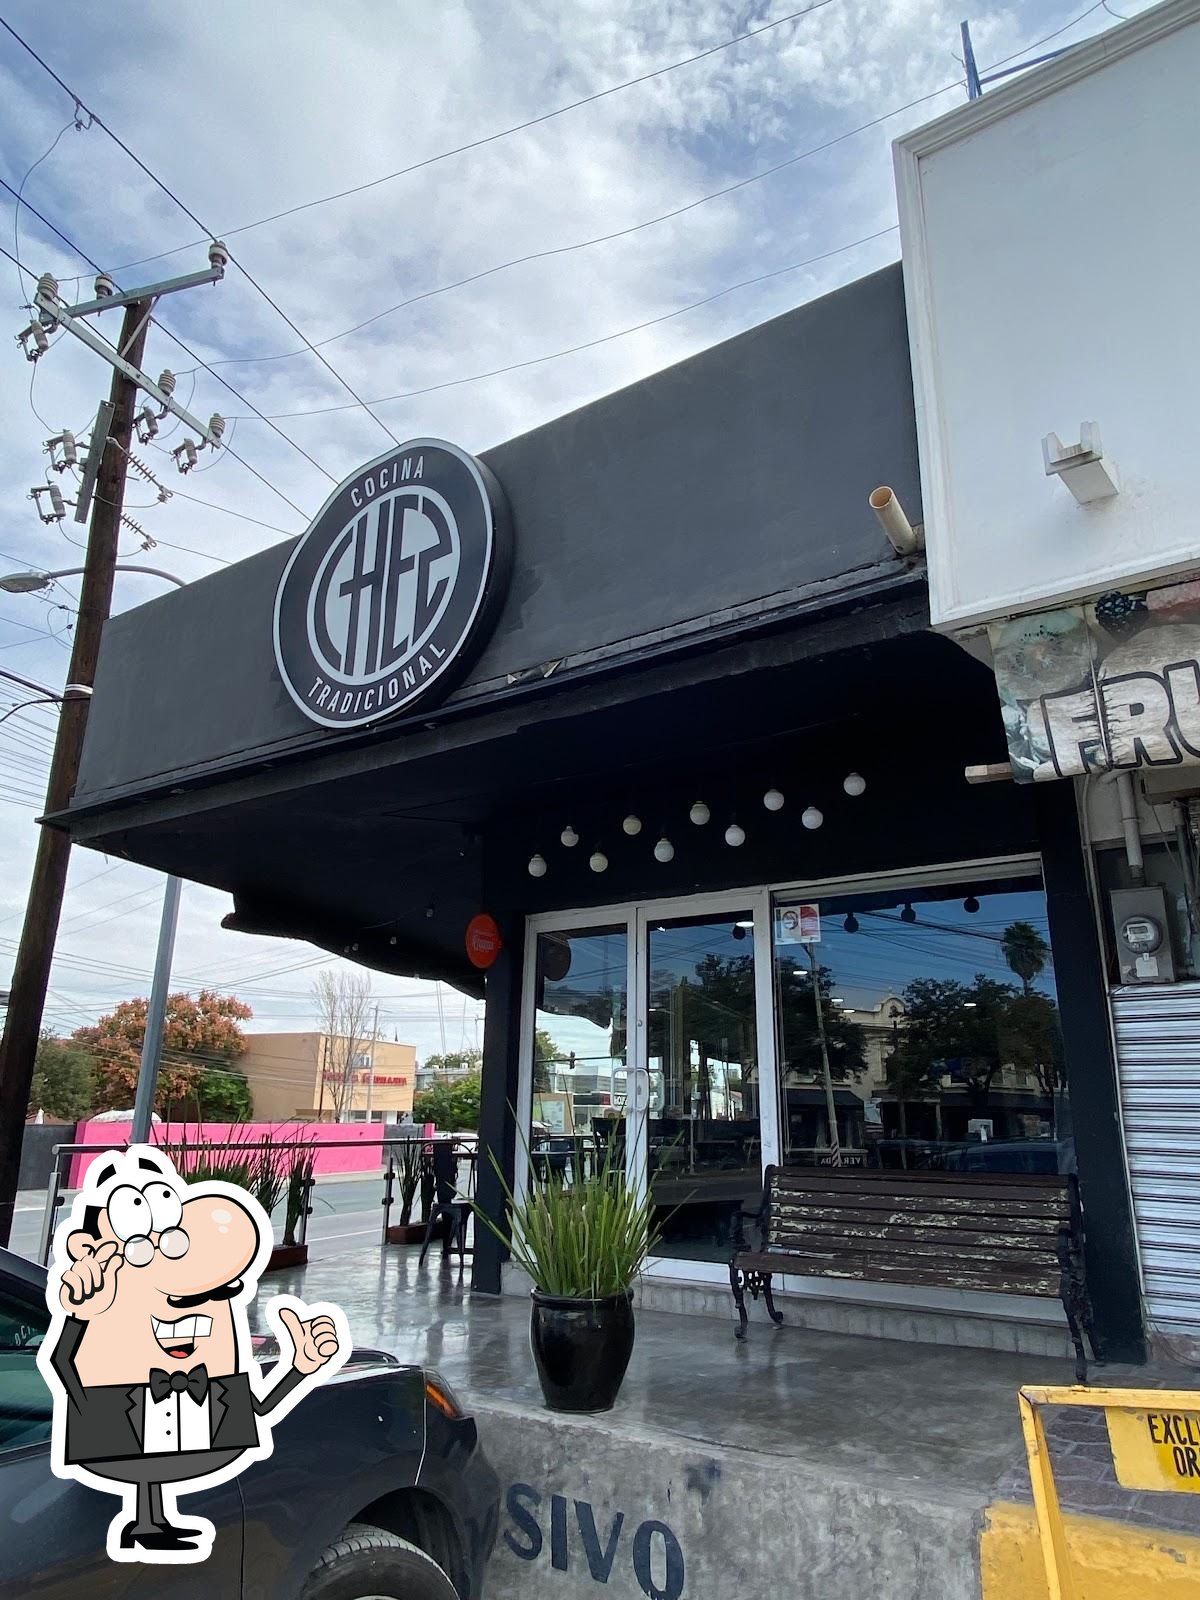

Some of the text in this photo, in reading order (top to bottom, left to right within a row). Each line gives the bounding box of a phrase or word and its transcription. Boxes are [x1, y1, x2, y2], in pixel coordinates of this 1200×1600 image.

[350, 455, 425, 508] COCINA
[306, 642, 446, 714] TRADICIONAL
[1147, 1413, 1200, 1446] EXCL
[503, 1483, 685, 1600] SIVO
